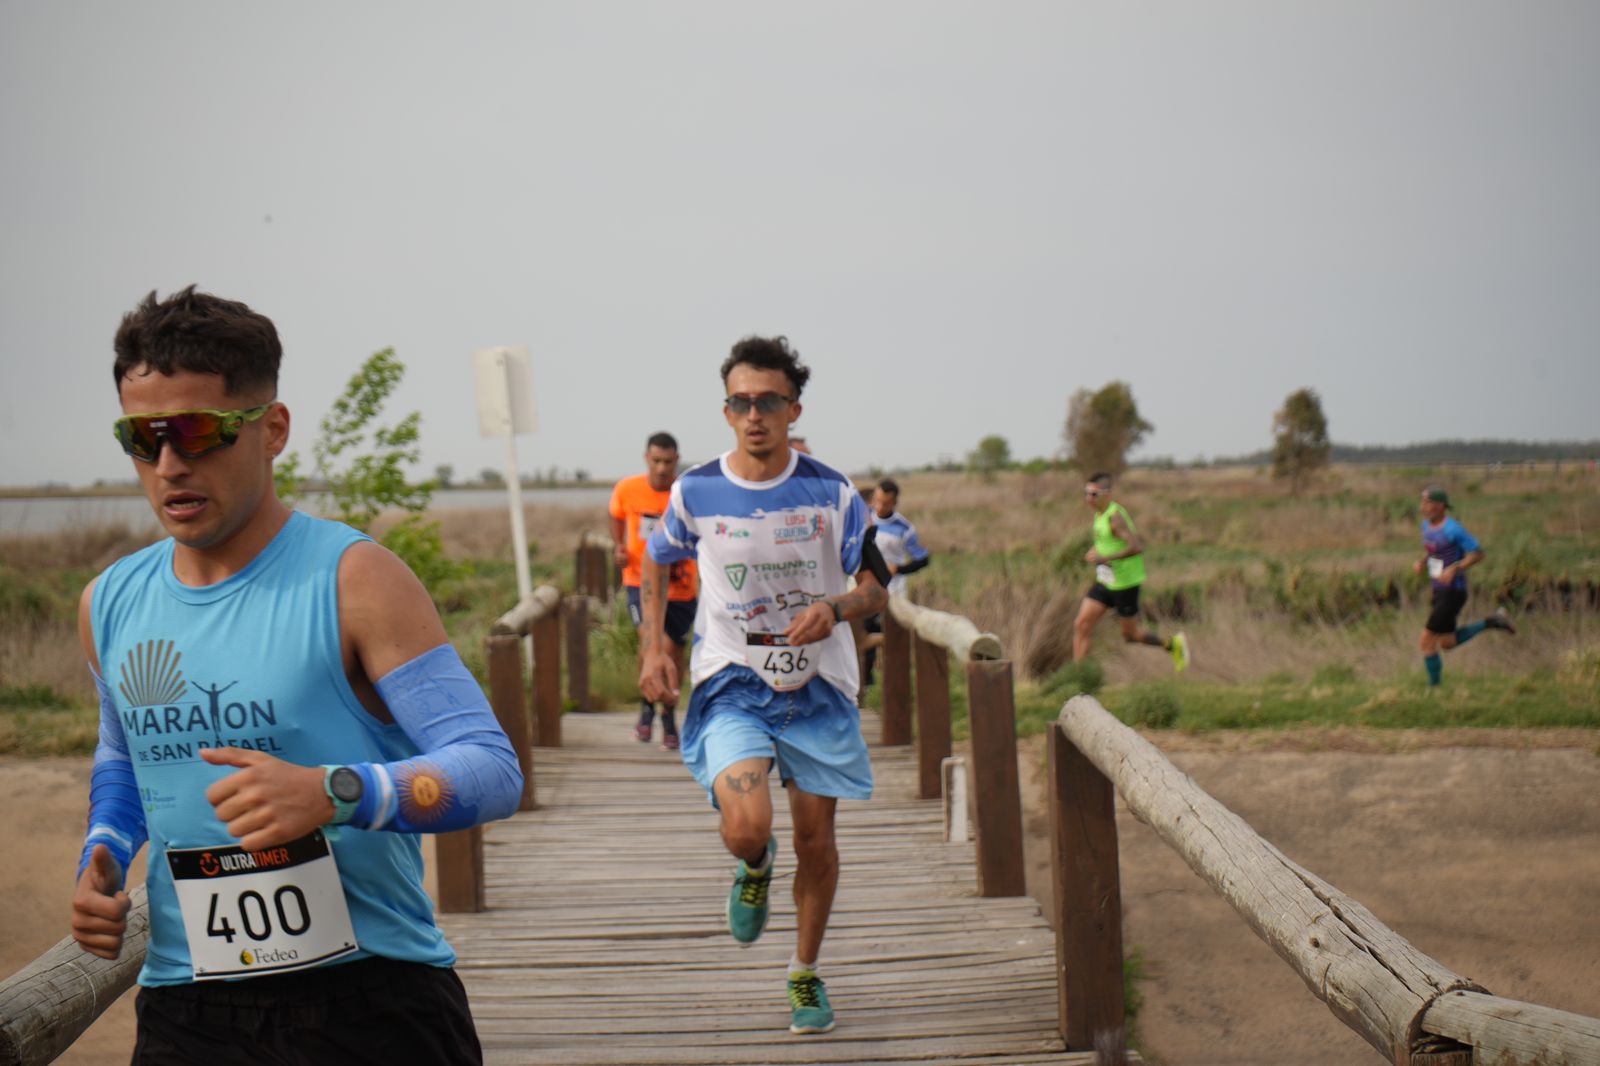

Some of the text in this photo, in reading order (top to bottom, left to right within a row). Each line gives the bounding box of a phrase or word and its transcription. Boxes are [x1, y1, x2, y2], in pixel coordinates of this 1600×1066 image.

[751, 559, 817, 573] TRIUNFO
[763, 647, 809, 675] 436
[150, 742, 193, 762] SAN
[206, 884, 312, 944] 400
